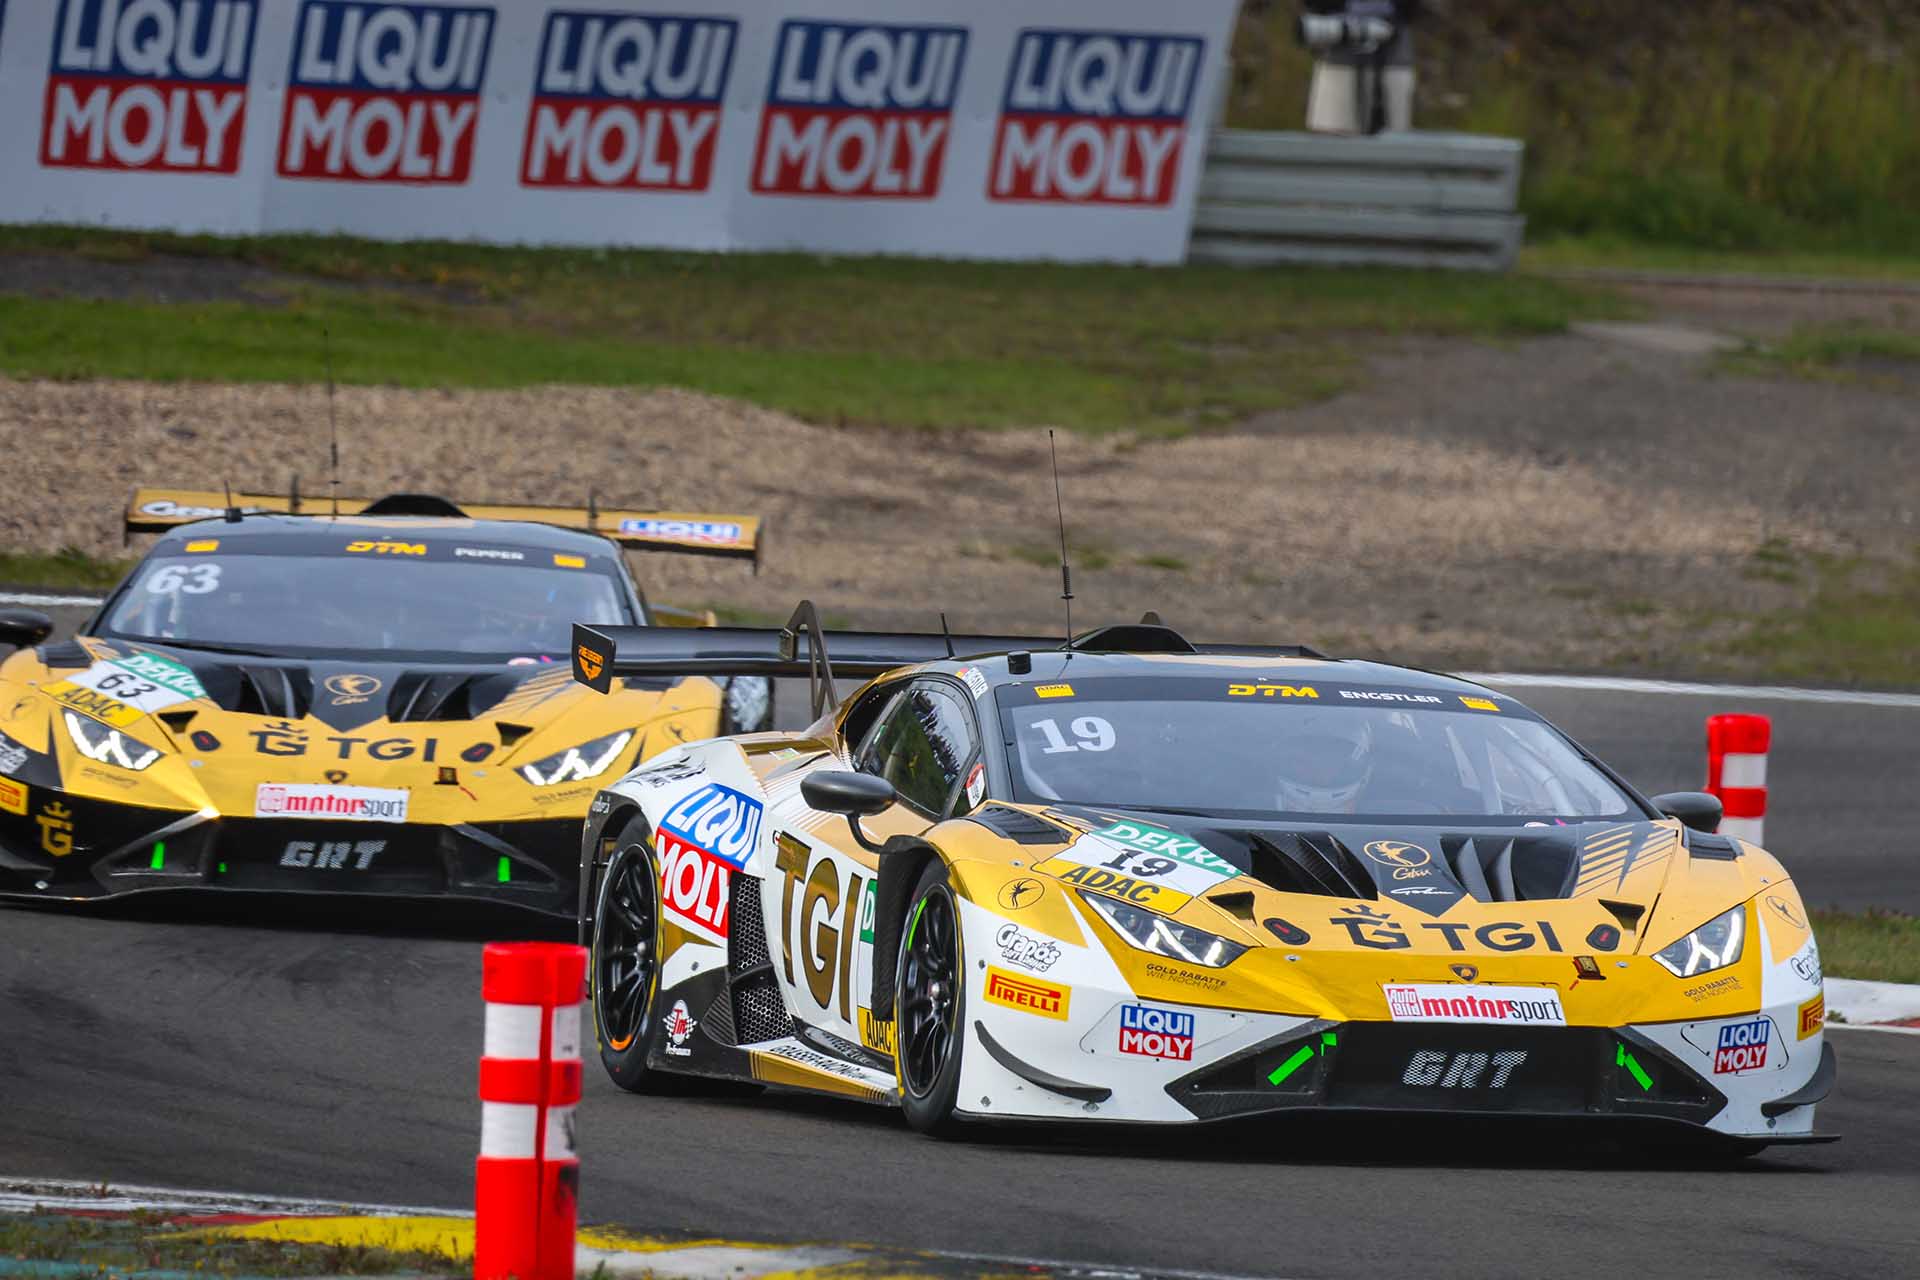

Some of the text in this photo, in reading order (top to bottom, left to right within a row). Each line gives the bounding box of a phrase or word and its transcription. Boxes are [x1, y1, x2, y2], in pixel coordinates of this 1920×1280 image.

[59, 0, 250, 79] LIQUI
[298, 5, 489, 90] LIQUI
[541, 17, 730, 99] LIQUI
[776, 27, 965, 108] LIQUI
[1011, 36, 1196, 114] LIQUI
[48, 85, 241, 167] MOLY
[285, 96, 475, 177] MOLY
[528, 104, 717, 187] MOLY
[761, 114, 947, 193] MOLY
[996, 122, 1184, 200] MOLY
[624, 520, 738, 540] LIQUI
[346, 541, 524, 560] DTM PEPPER
[146, 563, 222, 594] 63
[96, 673, 158, 699] 63
[124, 655, 206, 697] DEKRA
[1228, 684, 1319, 698] DTM
[1339, 690, 1443, 704] ENGSTLER
[61, 687, 125, 718] ADAC
[326, 736, 438, 762] TGI
[1030, 716, 1116, 754] 19
[666, 786, 761, 861] LIQUI
[279, 838, 388, 871] GRT
[1100, 848, 1178, 877] 19
[1107, 824, 1240, 874] DEKRA
[657, 833, 732, 929] MOLY
[1059, 866, 1161, 903] ADAC
[774, 830, 863, 1024] TGI
[1420, 921, 1564, 952] TGI
[988, 973, 1061, 1013] PIRELLI
[1146, 962, 1228, 987] GOLD RABATTE
[1123, 1006, 1191, 1036] LIQUI
[1422, 995, 1563, 1022] motorsport
[1122, 1032, 1192, 1059] MOLY
[1720, 1023, 1768, 1048] LIQUI
[1402, 1049, 1528, 1089] GRT
[1717, 1048, 1766, 1073] MOLY
